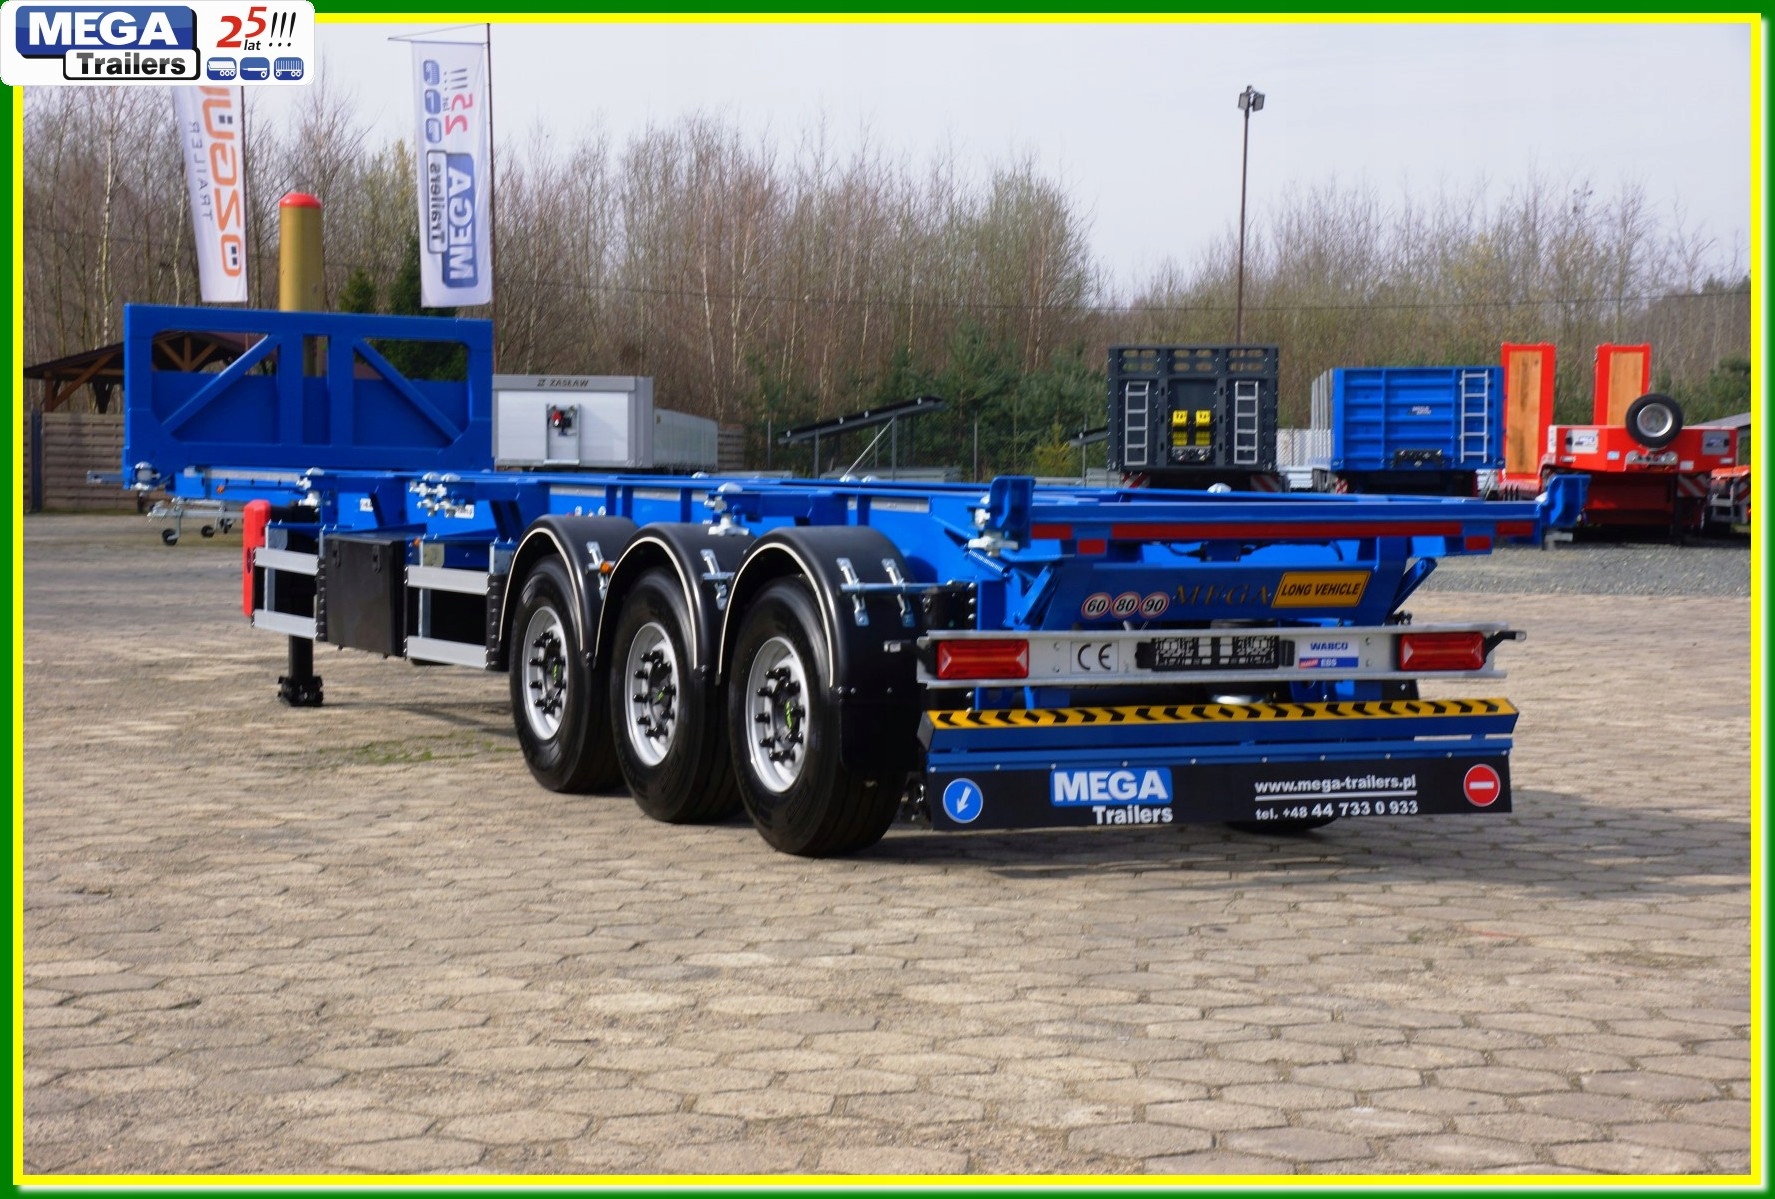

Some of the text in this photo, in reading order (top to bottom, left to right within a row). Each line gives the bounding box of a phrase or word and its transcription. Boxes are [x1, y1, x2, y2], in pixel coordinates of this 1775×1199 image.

[1281, 582, 1362, 596] LONG VEHICLE
[1087, 598, 1106, 612] 60
[1116, 598, 1135, 612] 80
[1144, 598, 1164, 612] 90
[1310, 641, 1348, 651] WABCO
[1054, 770, 1168, 802] MEGA
[1254, 774, 1417, 793] www.mega-trailers.pl
[1092, 804, 1173, 825] Trailers
[1255, 800, 1418, 820] tel. +48 44 733 0 933
